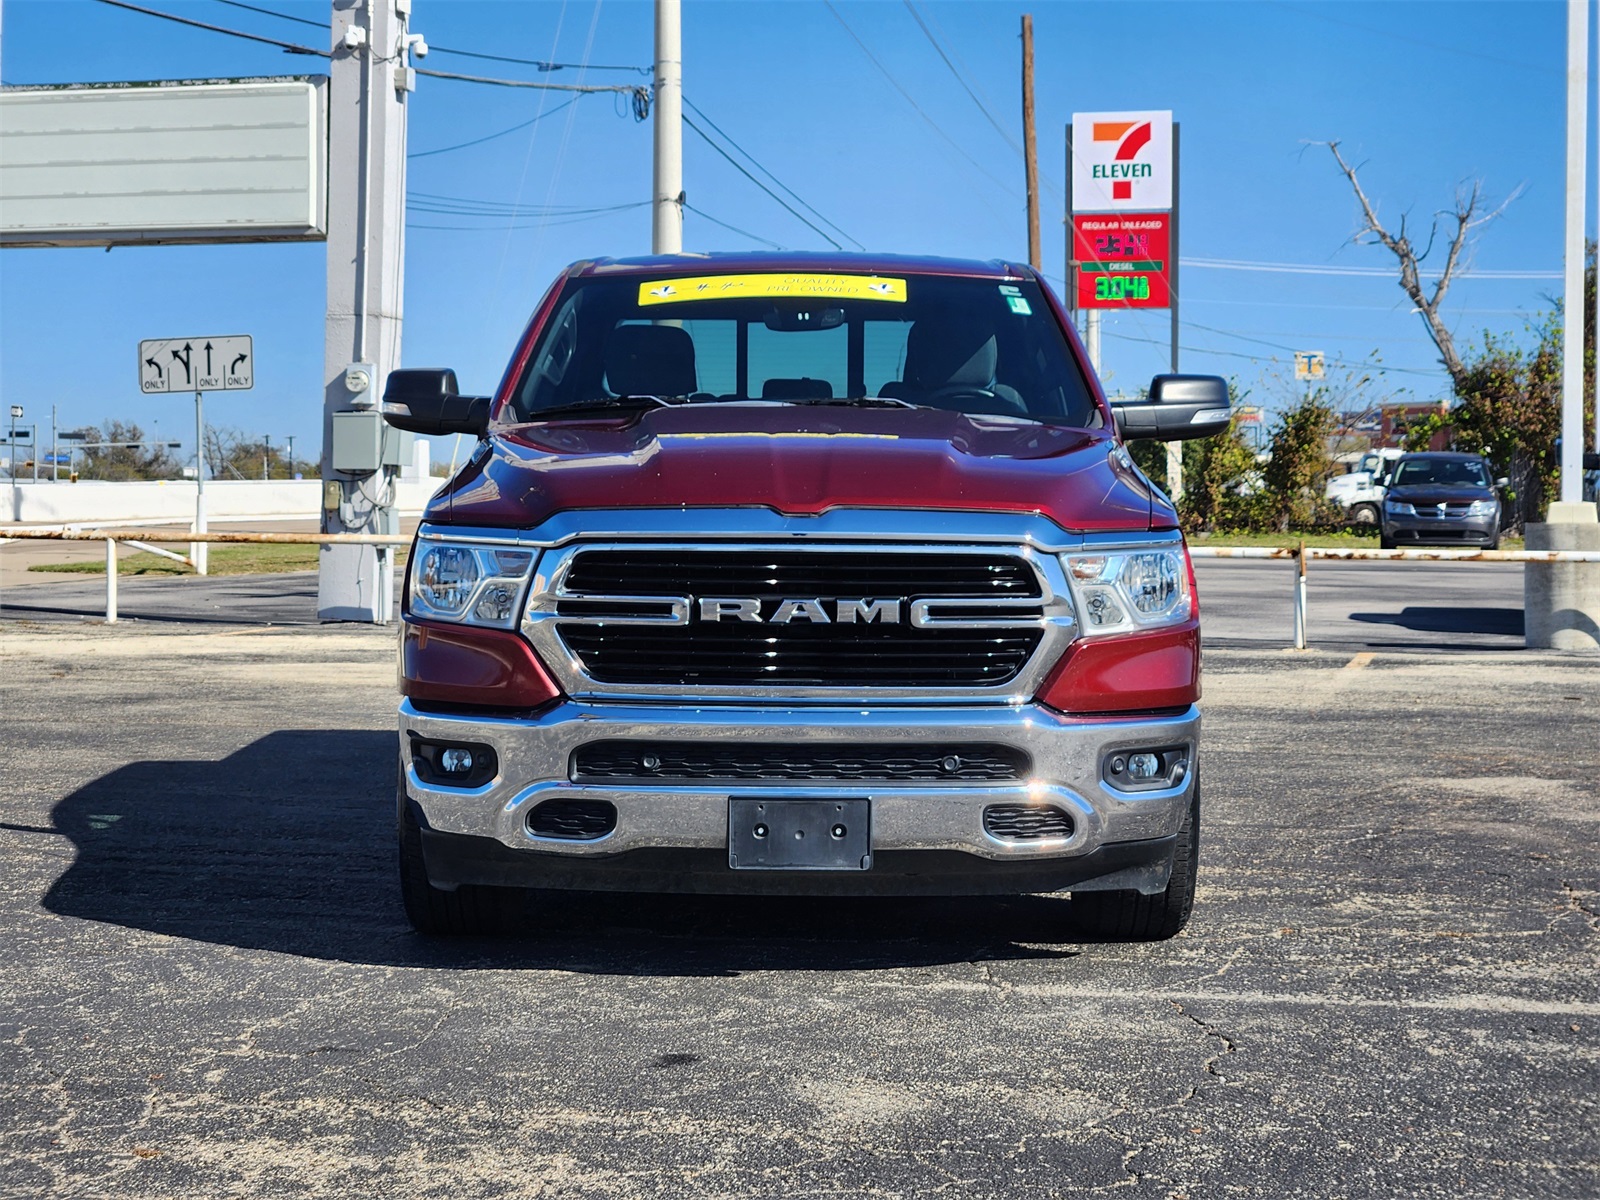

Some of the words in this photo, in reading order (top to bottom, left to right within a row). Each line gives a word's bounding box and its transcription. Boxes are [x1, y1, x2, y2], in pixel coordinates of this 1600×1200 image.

[1093, 121, 1151, 160] 7
[1081, 220, 1119, 231] REGULAR
[1120, 220, 1163, 230] UNLEADED
[1108, 262, 1135, 271] DIESEL
[144, 380, 166, 390] ONLY
[199, 377, 219, 387] ONLY
[227, 376, 250, 386] ONLY
[698, 597, 901, 624] RAM
